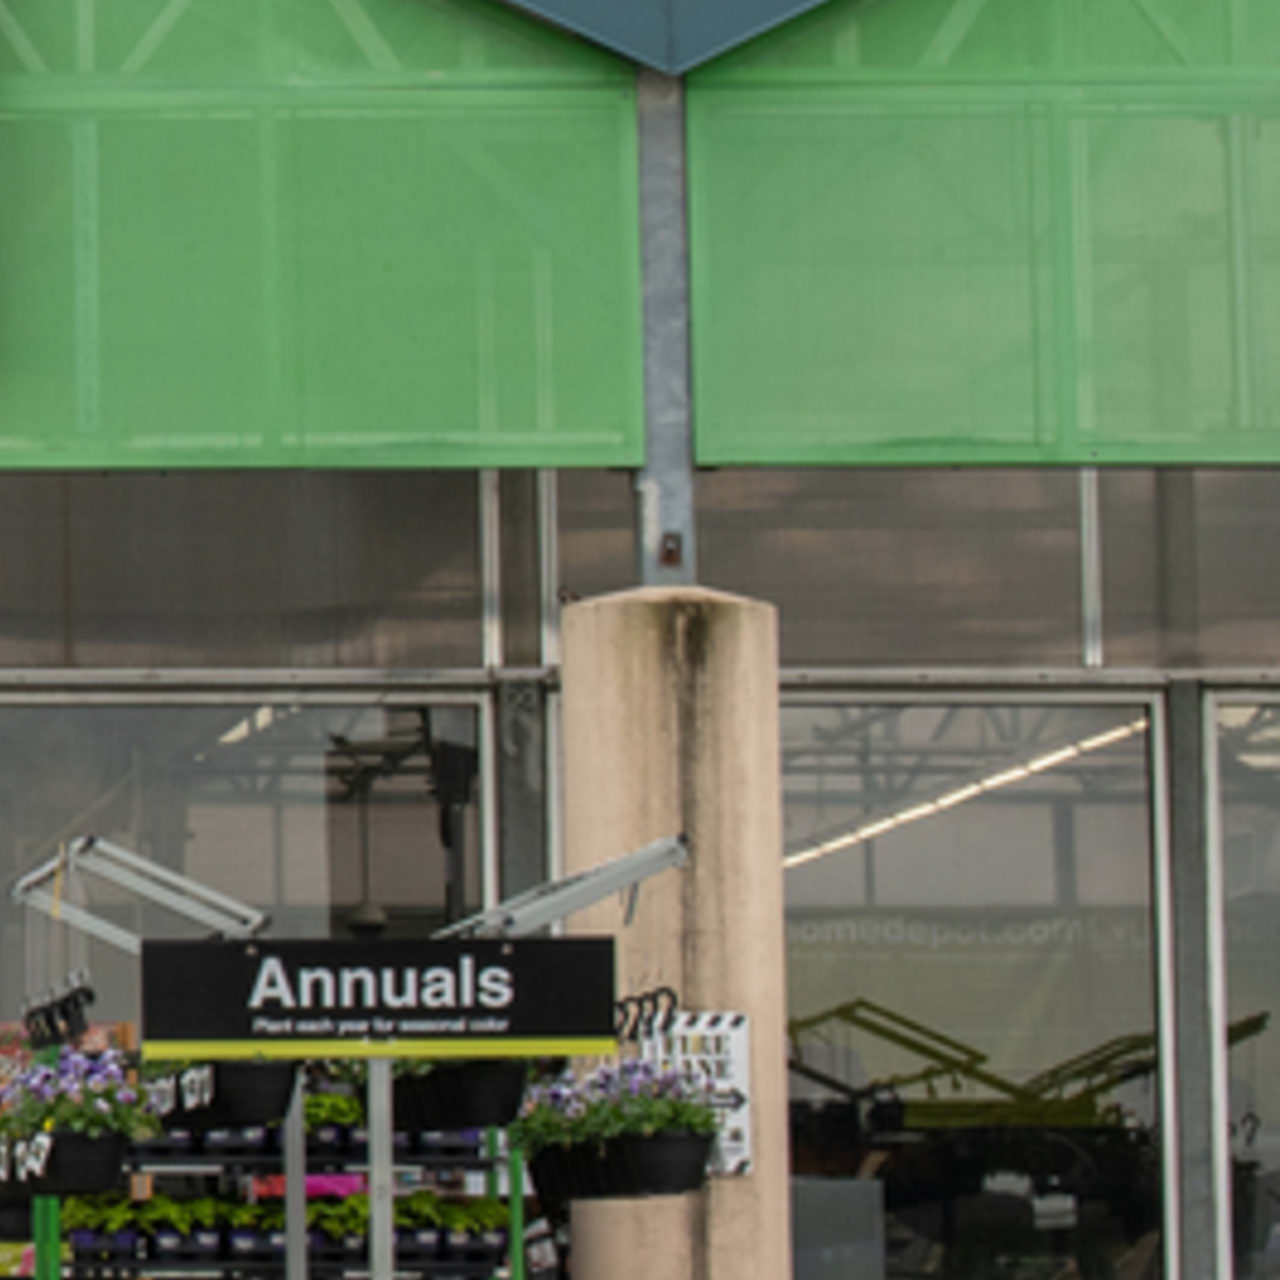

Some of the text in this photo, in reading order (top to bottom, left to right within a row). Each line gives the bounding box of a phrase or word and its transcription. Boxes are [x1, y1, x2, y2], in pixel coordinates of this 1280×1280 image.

[787, 914, 1082, 950] omedepot.com
[247, 955, 515, 1010] Annuals
[252, 1017, 292, 1033] Plant
[294, 1017, 336, 1033] each
[372, 1017, 396, 1033] for
[398, 1017, 467, 1033] seasonal
[469, 1017, 511, 1033] color
[663, 1059, 731, 1080] ANE
